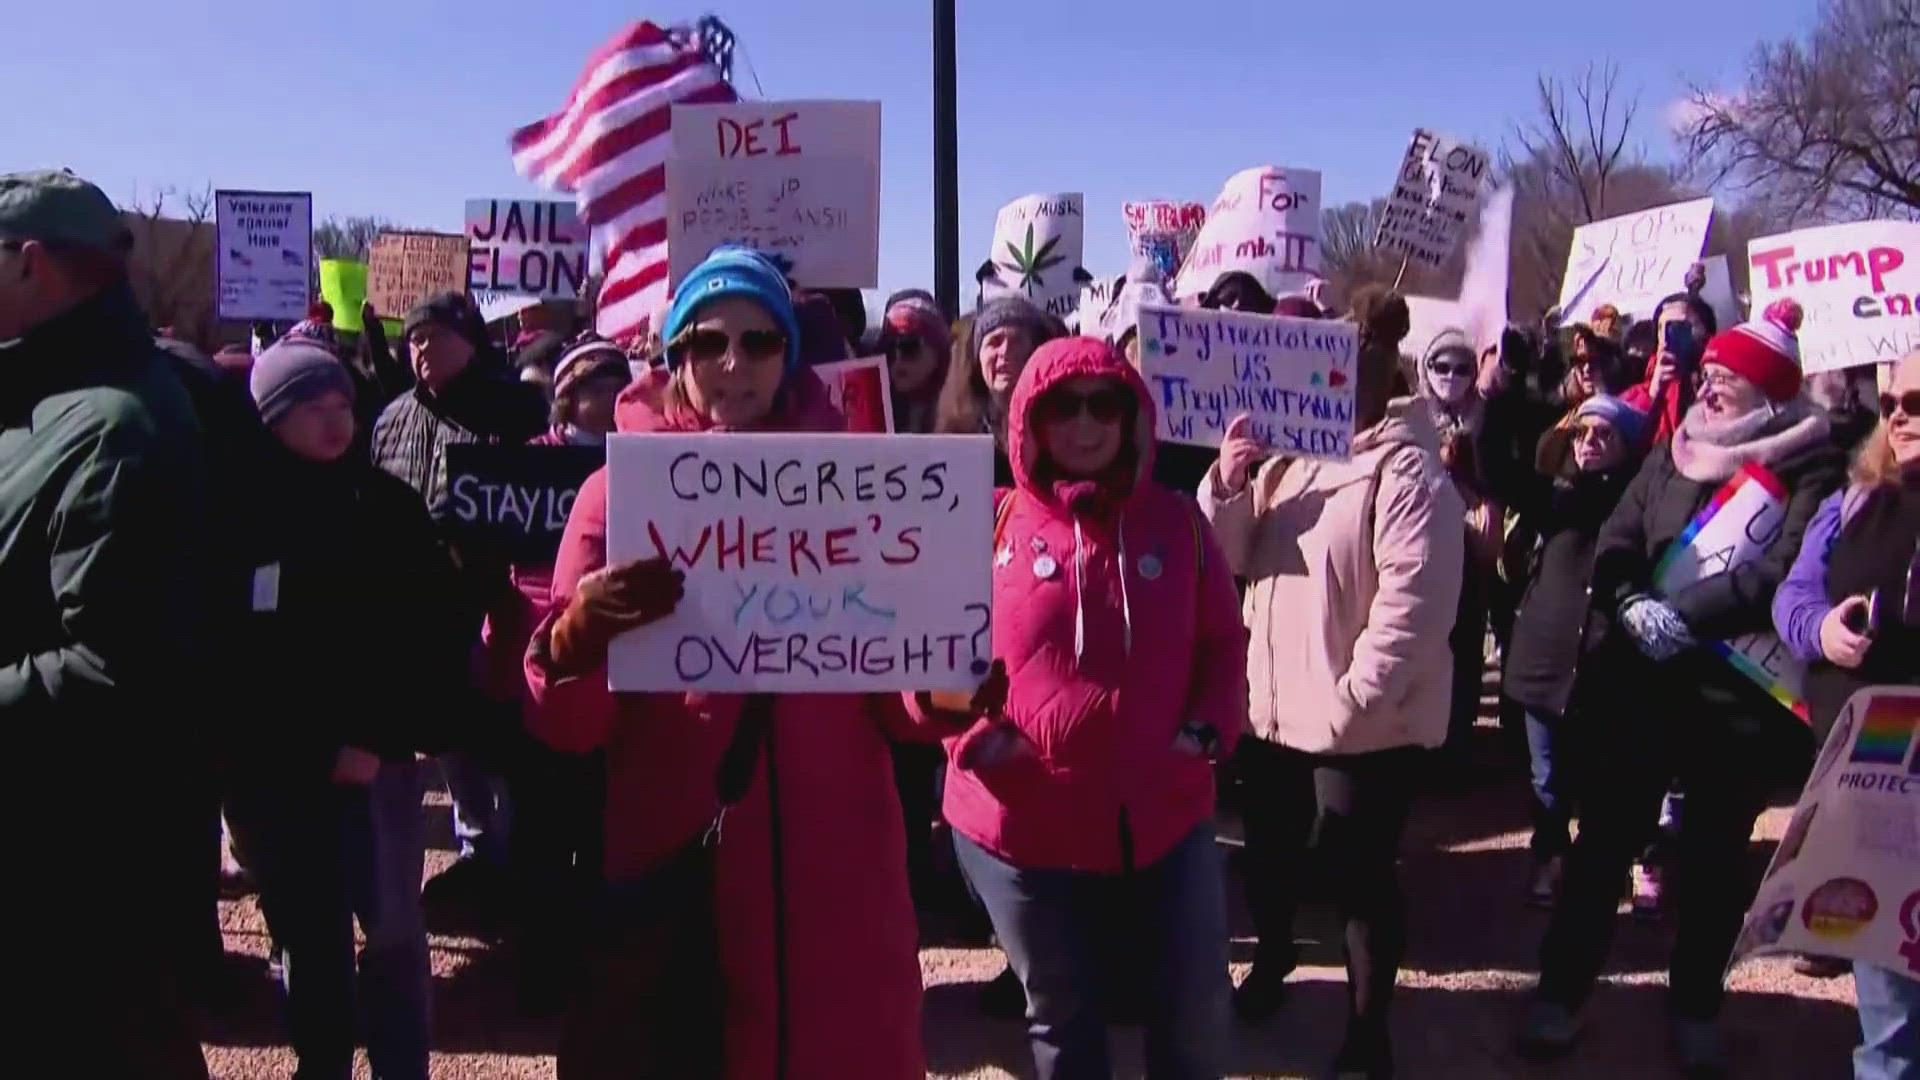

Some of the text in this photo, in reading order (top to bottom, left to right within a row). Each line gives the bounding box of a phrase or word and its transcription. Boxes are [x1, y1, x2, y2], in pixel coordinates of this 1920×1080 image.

[717, 111, 802, 158] DEI
[1035, 199, 1081, 218] MUSK
[1259, 173, 1309, 212] For
[473, 198, 573, 244] JAIL
[468, 246, 585, 299] ELON
[1750, 245, 1905, 294] Trump
[1852, 292, 1920, 319] en
[453, 473, 541, 535] STAY
[669, 451, 960, 512] CONGRESS,
[646, 513, 922, 577] WHERE'S
[732, 582, 896, 628] YOUR
[674, 602, 991, 683] OVERSIGHT?
